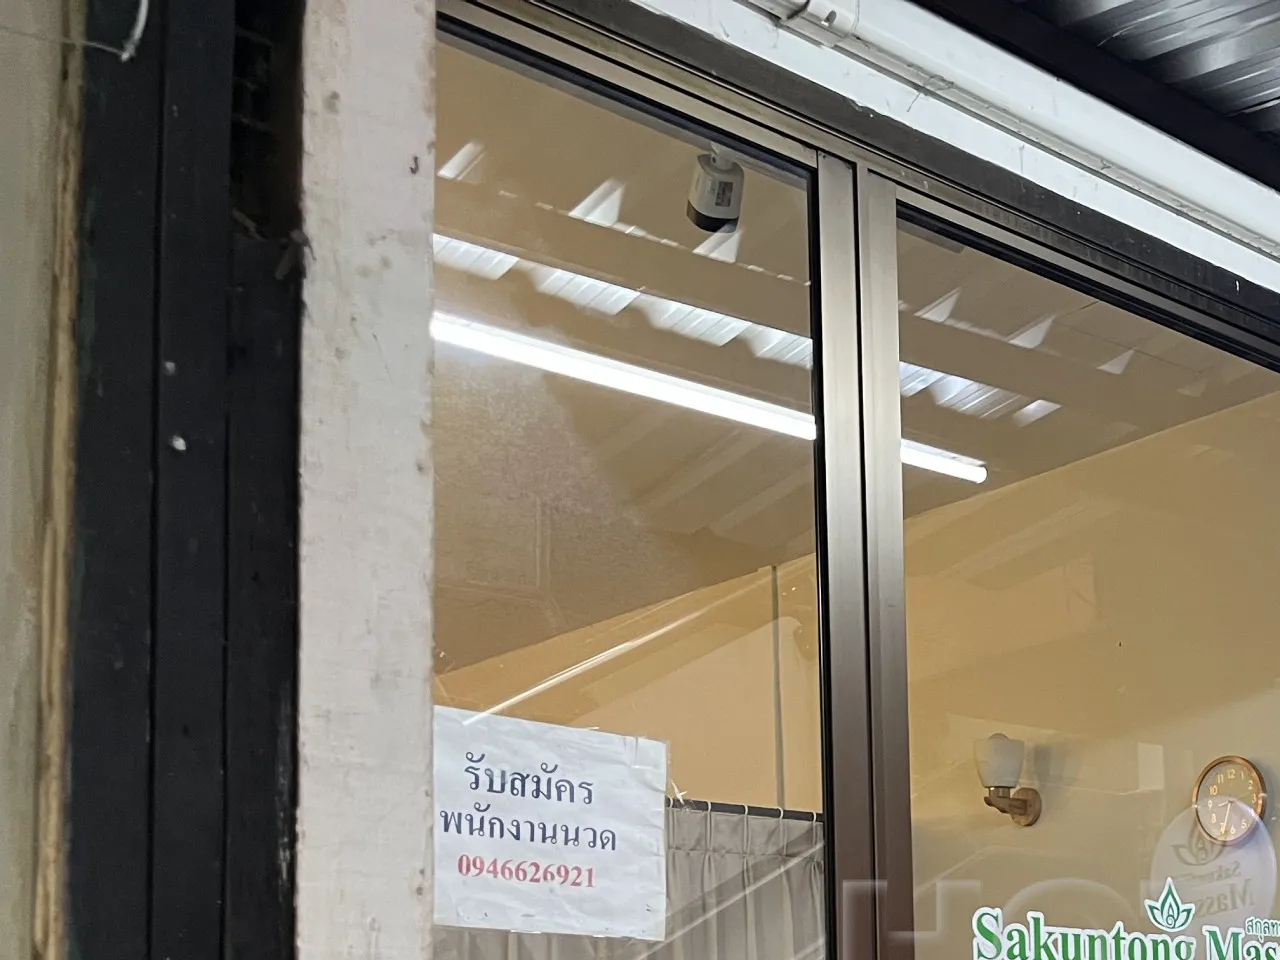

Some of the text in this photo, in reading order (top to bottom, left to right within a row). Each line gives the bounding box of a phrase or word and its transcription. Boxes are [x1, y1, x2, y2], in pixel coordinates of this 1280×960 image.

[464, 751, 594, 804] รับสมัคร
[440, 802, 616, 851] พนักงานนวด
[457, 854, 596, 888] 0946626921
